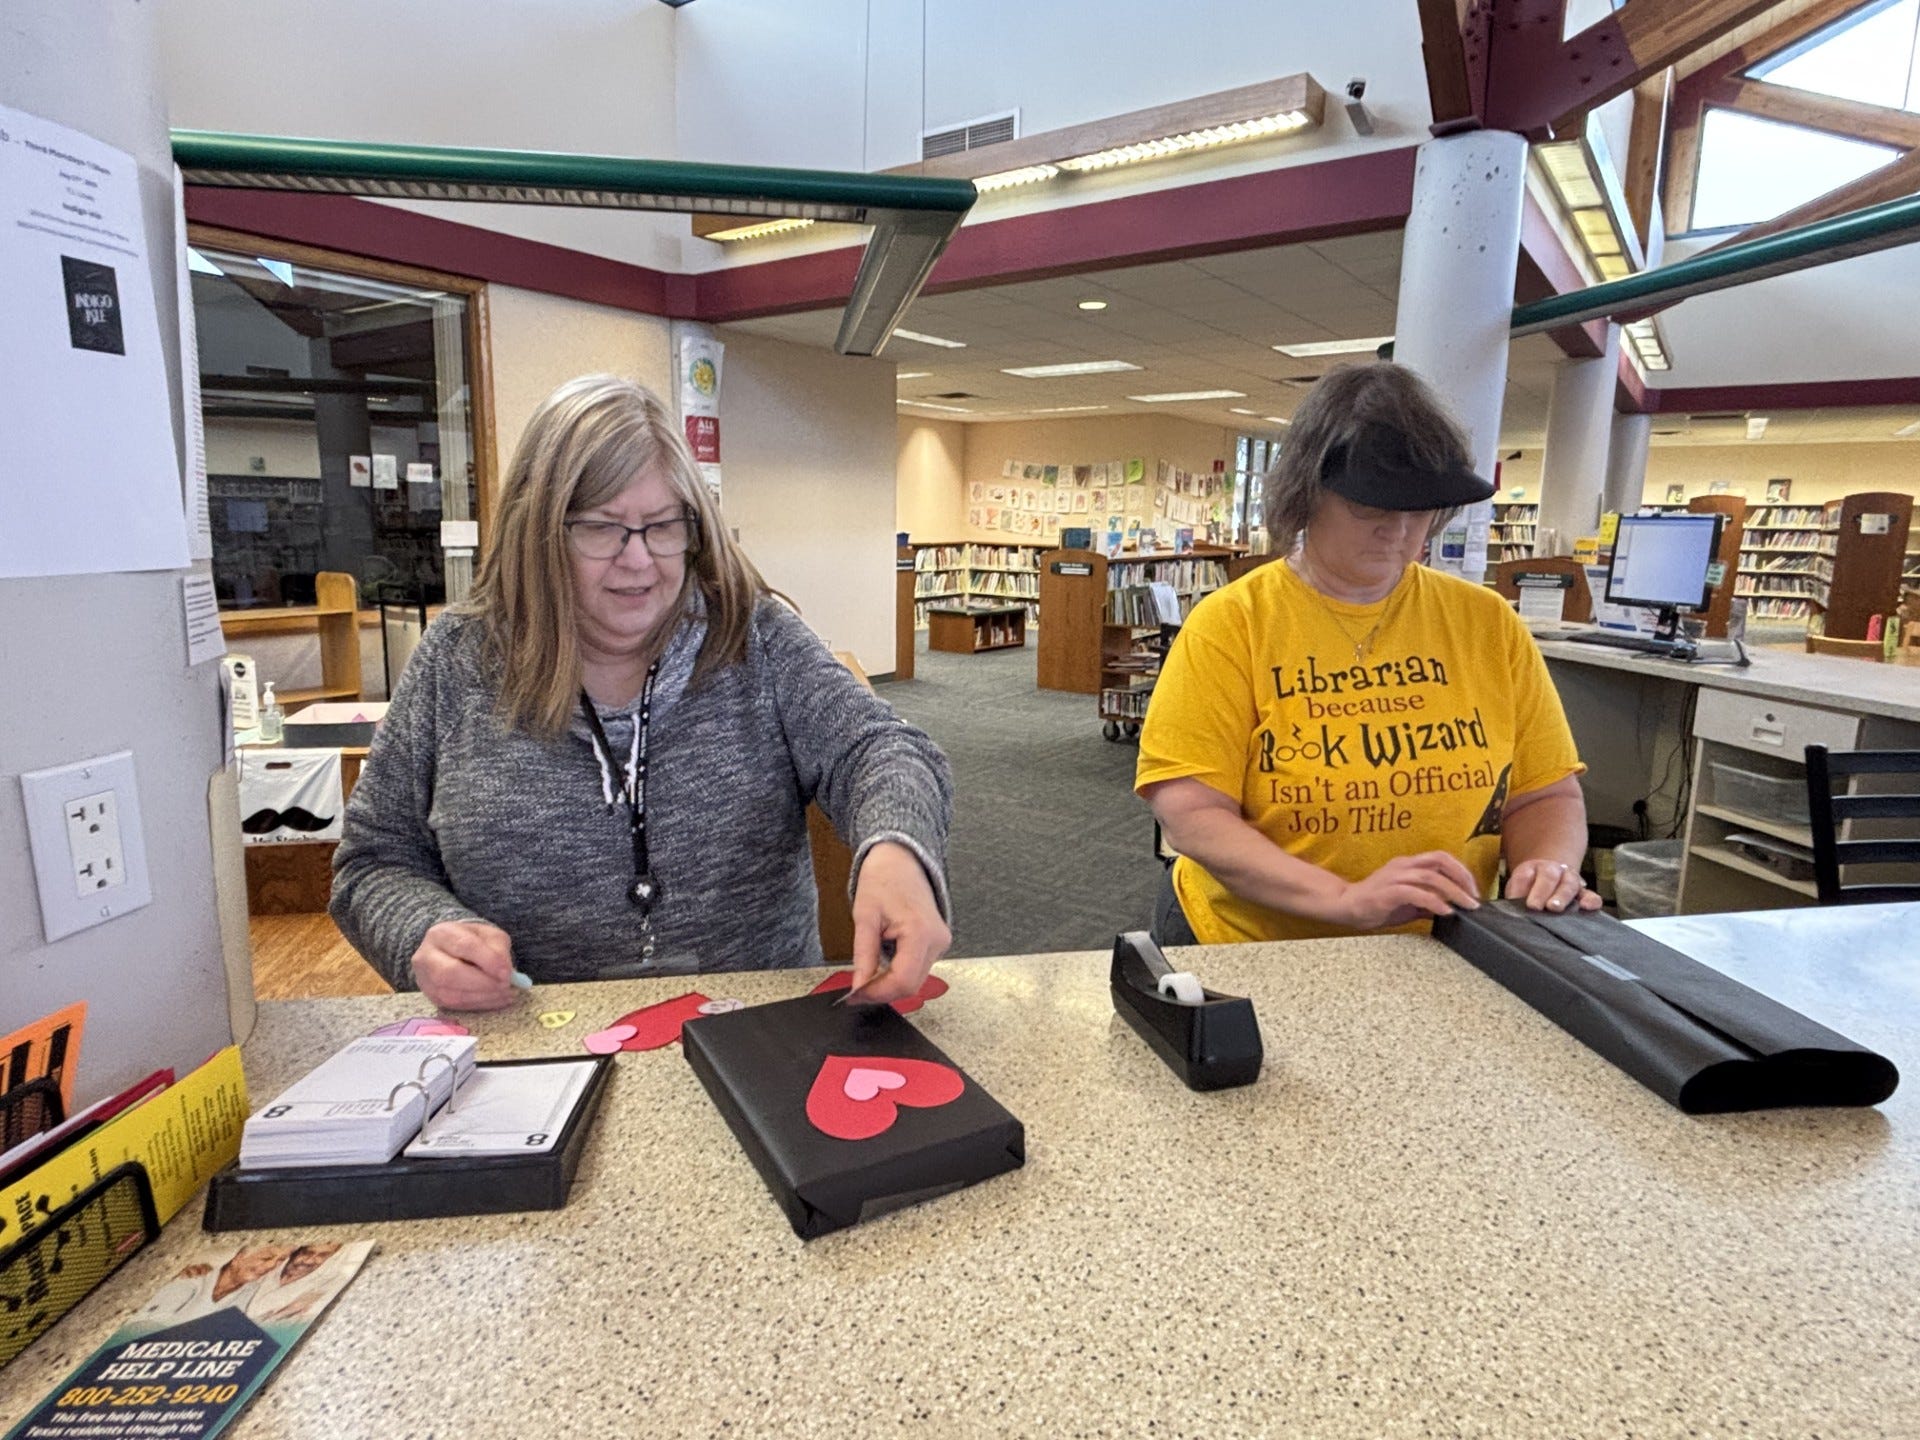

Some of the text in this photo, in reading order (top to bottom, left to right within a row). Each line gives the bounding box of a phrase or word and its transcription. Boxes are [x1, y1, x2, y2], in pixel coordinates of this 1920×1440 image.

[1272, 656, 1448, 699] Librarian
[1305, 695, 1425, 719] because
[1360, 707, 1488, 768] Wizard
[1270, 761, 1495, 804] Isn't an Official
[1289, 803, 1412, 834] Job Title
[263, 1105, 292, 1119] 8
[525, 1133, 549, 1146] 8
[117, 1340, 262, 1360] MEDICARE
[97, 1360, 244, 1381] HELP LINE
[56, 1384, 239, 1407] 800-252-9240
[50, 1409, 205, 1424] This free help line guides
[25, 1422, 204, 1437] Texas residents through the
